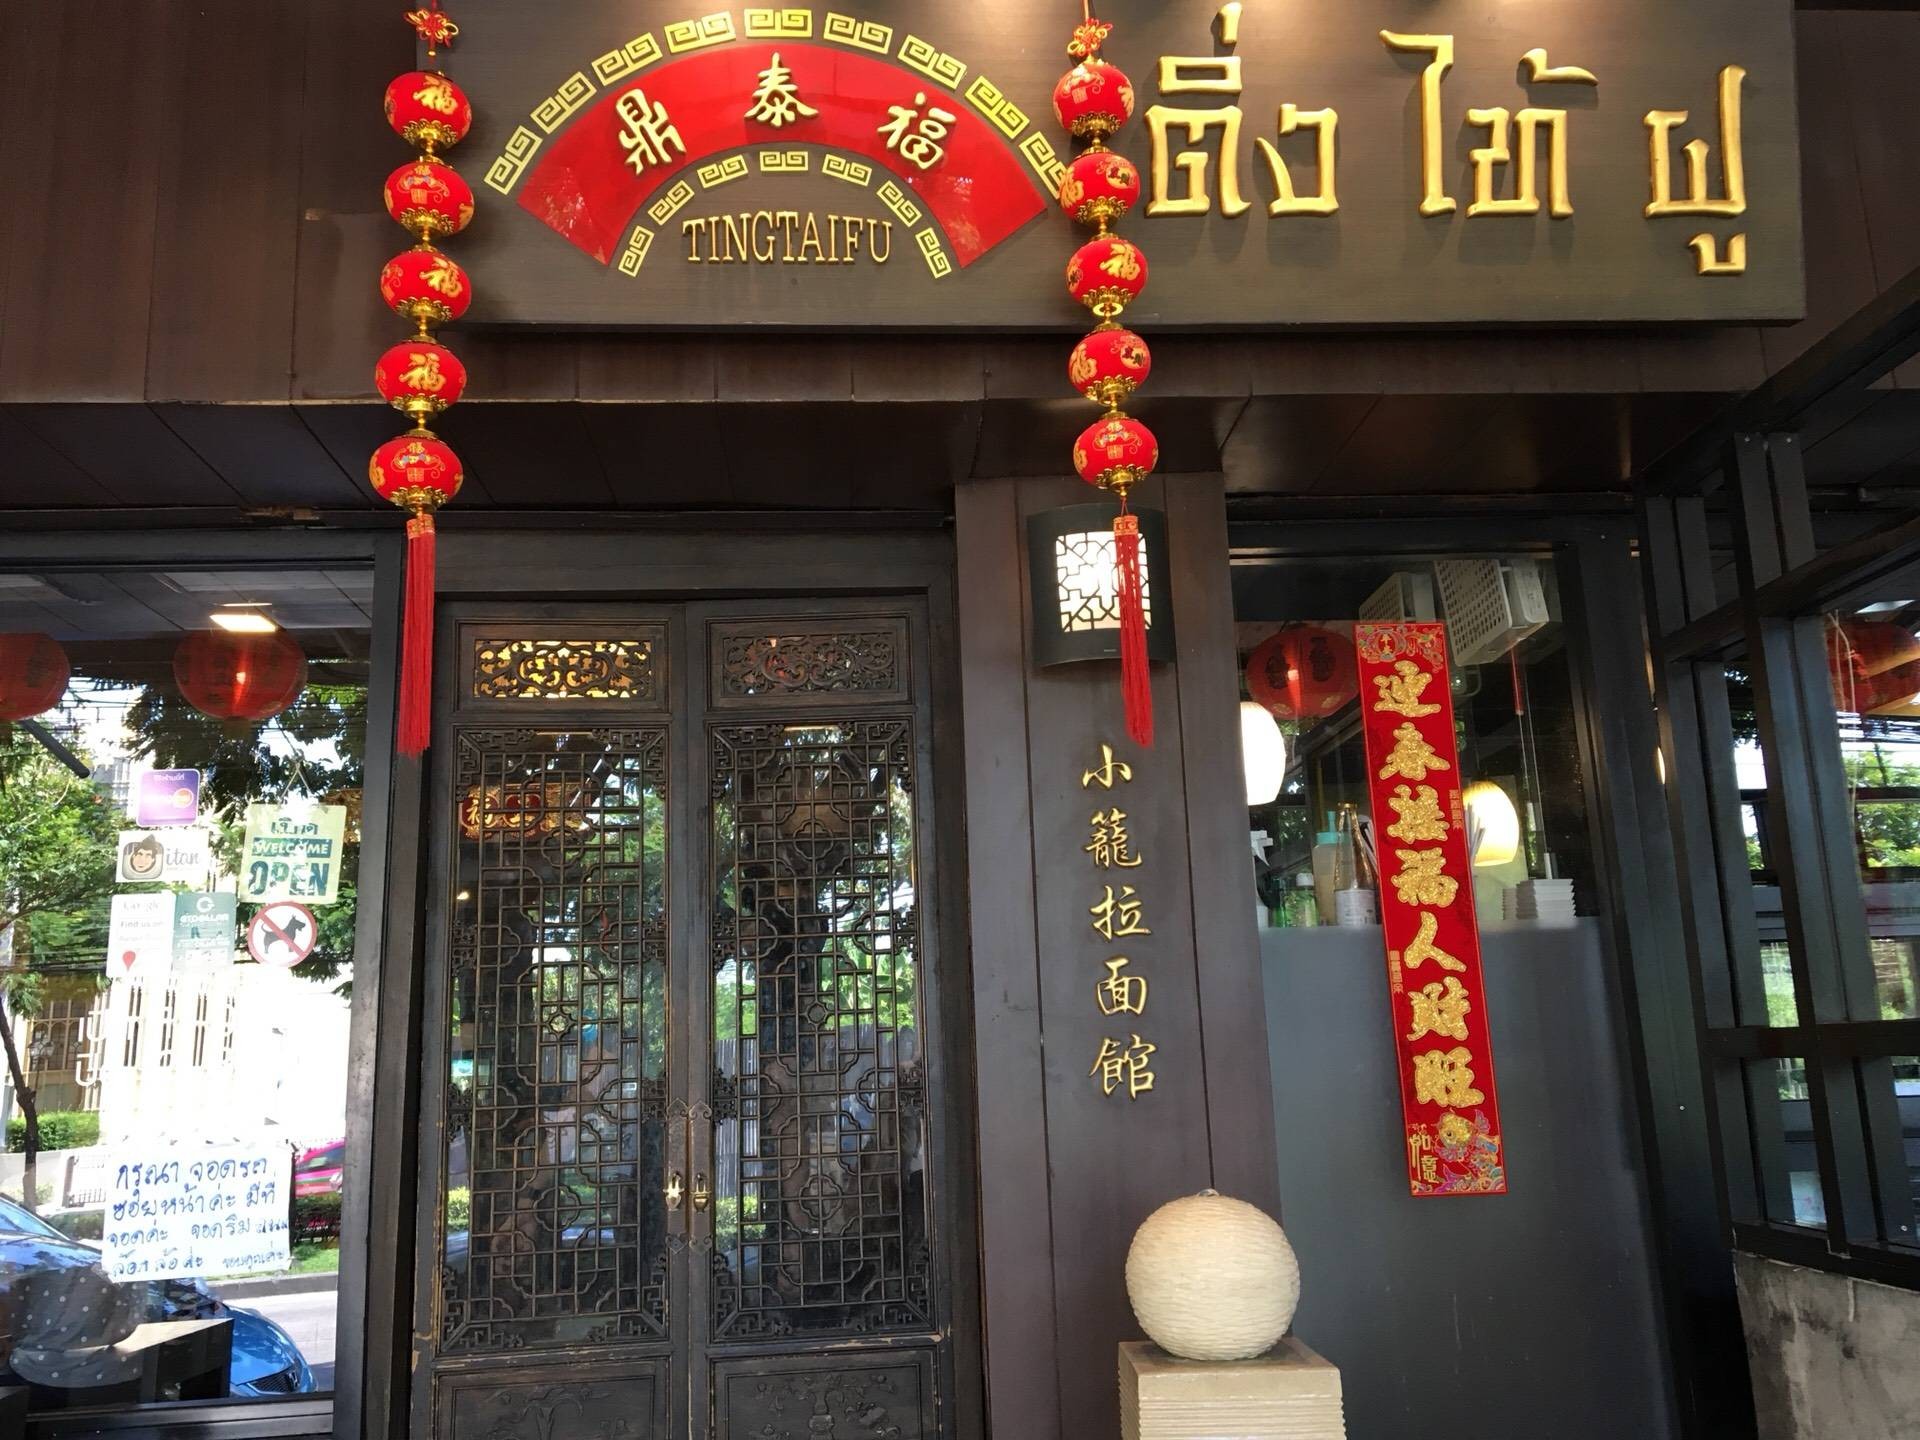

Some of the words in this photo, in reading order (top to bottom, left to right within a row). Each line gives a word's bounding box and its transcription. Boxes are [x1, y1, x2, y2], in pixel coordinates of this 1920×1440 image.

[616, 52, 957, 175] 鼎泰福
[682, 210, 893, 266] TINGTAIFU
[254, 838, 330, 856] WELCOME
[248, 860, 330, 897] OPEN
[1081, 743, 1158, 1101] 小籠拉面館
